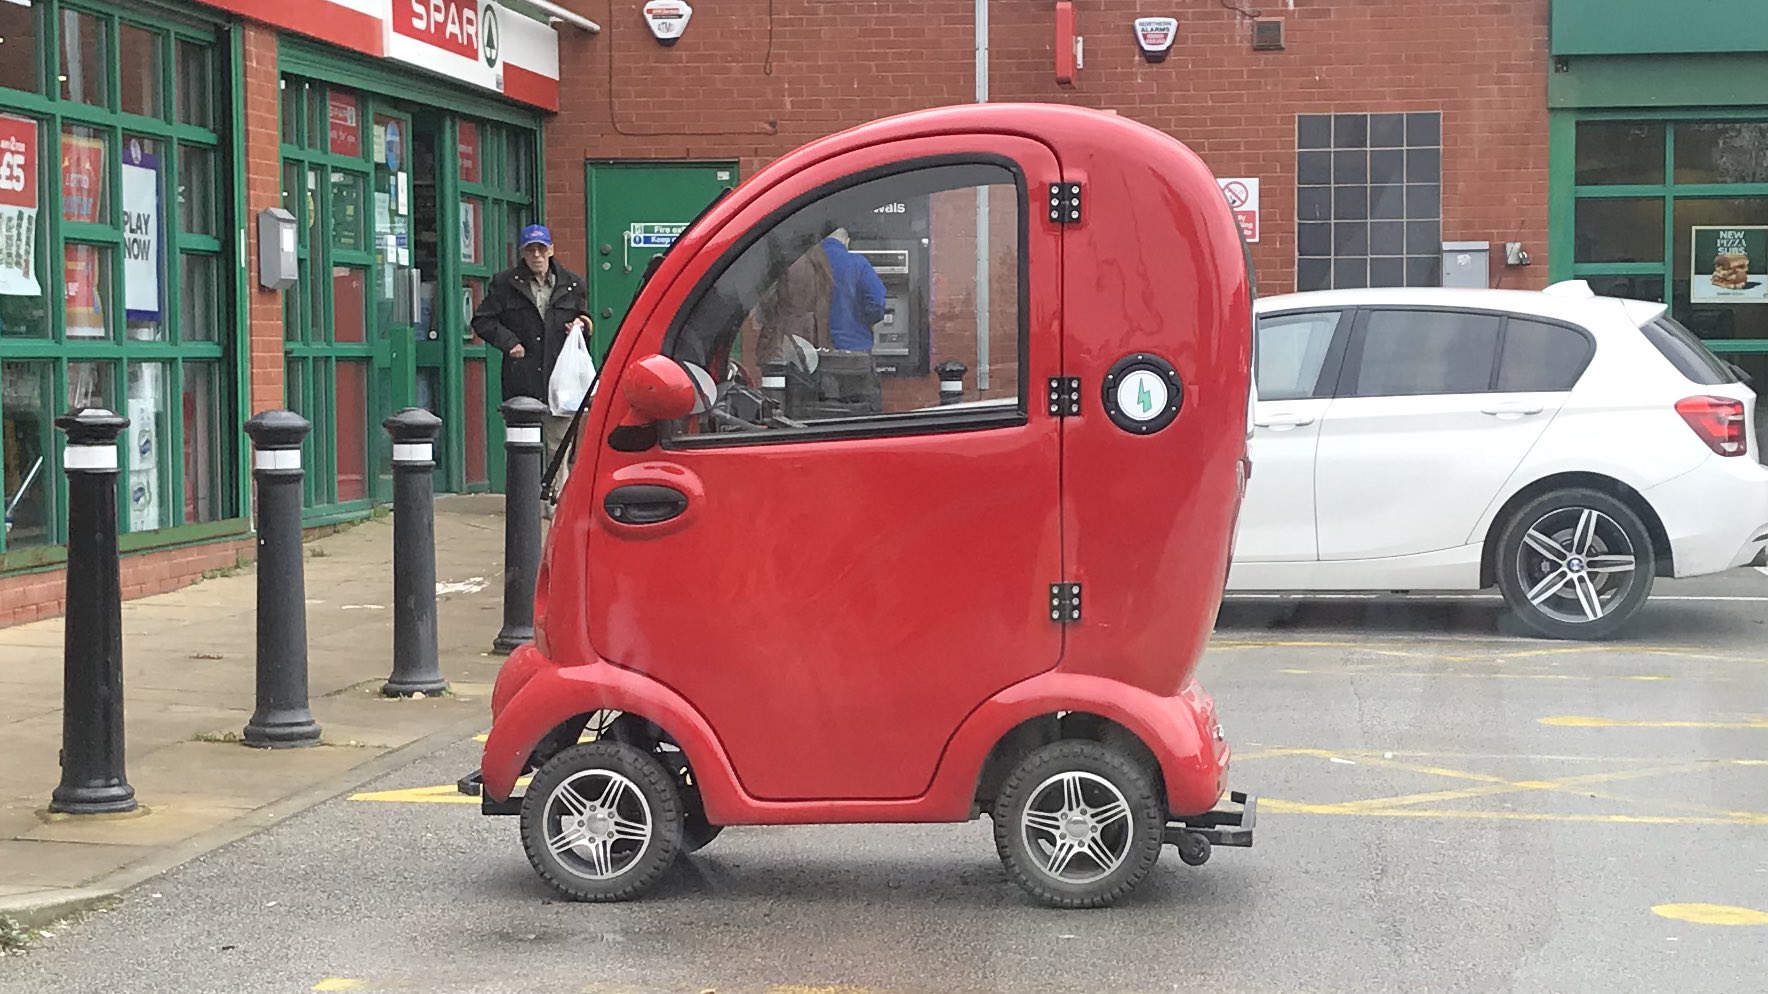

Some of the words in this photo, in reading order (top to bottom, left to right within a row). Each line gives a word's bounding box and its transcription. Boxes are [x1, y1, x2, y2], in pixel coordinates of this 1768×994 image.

[411, 0, 478, 49] SPAR
[0, 152, 25, 192] £5
[123, 210, 151, 236] PLAY
[654, 226, 671, 234] Fire
[1719, 231, 1744, 239] NEW
[124, 237, 151, 261] NOW
[1716, 239, 1746, 247] PIZZA
